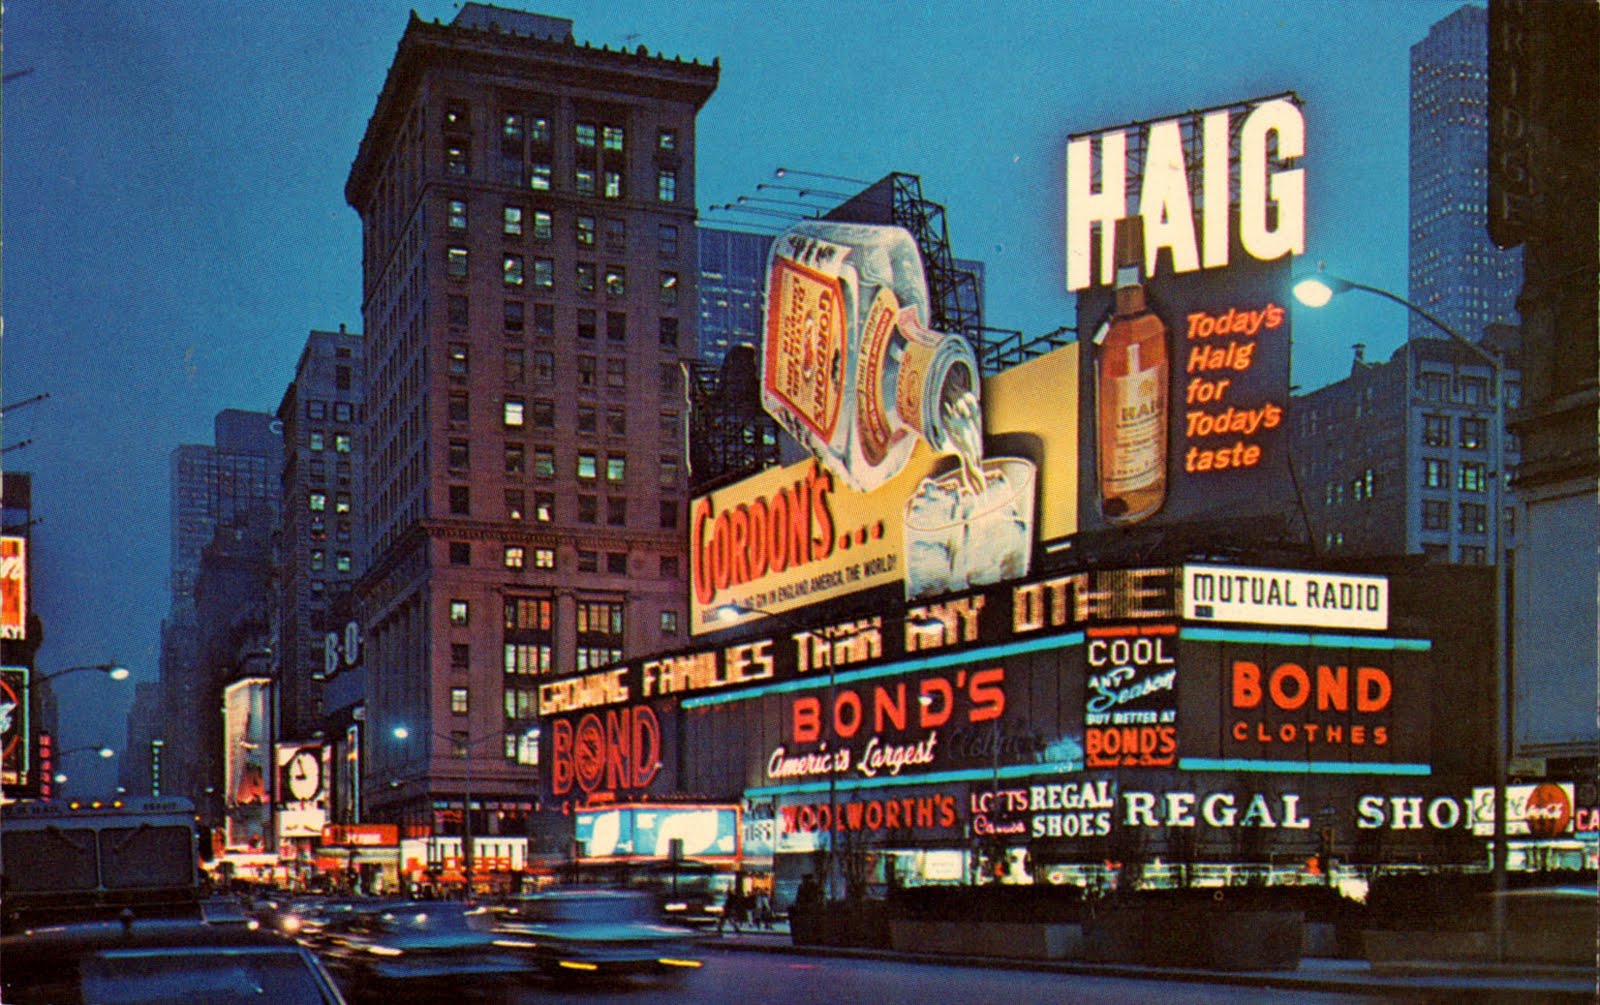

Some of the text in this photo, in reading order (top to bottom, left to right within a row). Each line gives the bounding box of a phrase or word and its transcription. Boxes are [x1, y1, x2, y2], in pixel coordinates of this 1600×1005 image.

[1066, 99, 1306, 292] HAIG
[1187, 303, 1285, 339] Today's
[1187, 342, 1256, 373] Haig
[1187, 377, 1231, 403] for
[1186, 404, 1282, 438] Today's
[1185, 442, 1260, 473] taste
[1193, 573, 1379, 611] MUTUAL RADIO
[643, 639, 774, 696] FAMILIES
[793, 616, 882, 673] THAN
[904, 594, 986, 654] ANY
[1087, 637, 1176, 666] COOL
[1086, 666, 1177, 712] Season
[1232, 661, 1392, 712] BOND
[793, 668, 1006, 743] BOND'S
[1086, 709, 1176, 725] BUY BETTER AT
[553, 705, 661, 795] BOND
[1086, 727, 1177, 754] BOND'S
[1233, 722, 1389, 745] CLOTHES
[857, 730, 938, 778] Largest
[780, 794, 956, 834] WOOLWORTH'S
[1030, 781, 1114, 812] REGAL
[1123, 792, 1310, 829] REGAL
[1031, 811, 1111, 838] SHOES
